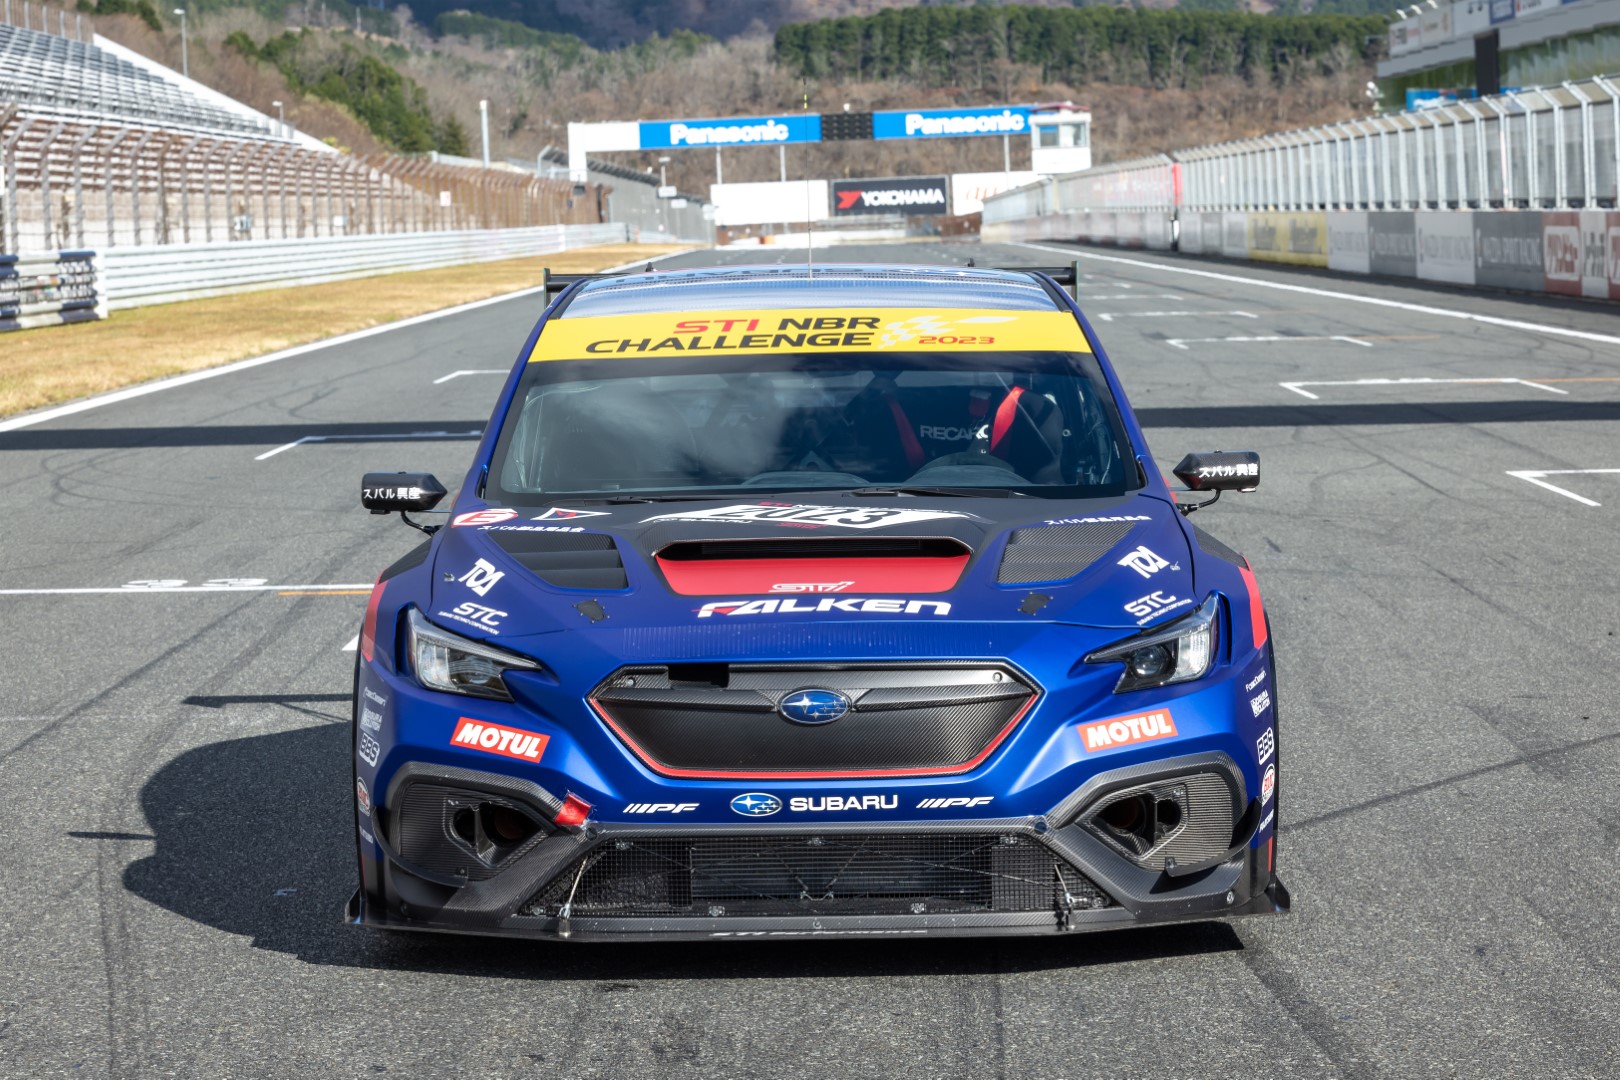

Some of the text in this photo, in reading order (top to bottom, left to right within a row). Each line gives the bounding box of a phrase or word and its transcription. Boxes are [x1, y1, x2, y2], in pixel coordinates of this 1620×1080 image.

[669, 119, 789, 146] Panasonic
[905, 110, 1026, 136] Panasonic
[861, 187, 945, 207] YOKOHAMA
[673, 317, 881, 334] STI NBR
[585, 331, 996, 354] CHALLENGE 2023
[709, 507, 902, 525] 2023
[453, 602, 508, 626] STC
[696, 598, 952, 618] FALKEN
[1124, 590, 1177, 617] STC
[455, 722, 542, 758] MOTUL
[1086, 713, 1172, 748] MOTUL
[789, 795, 898, 811] SUBARU
